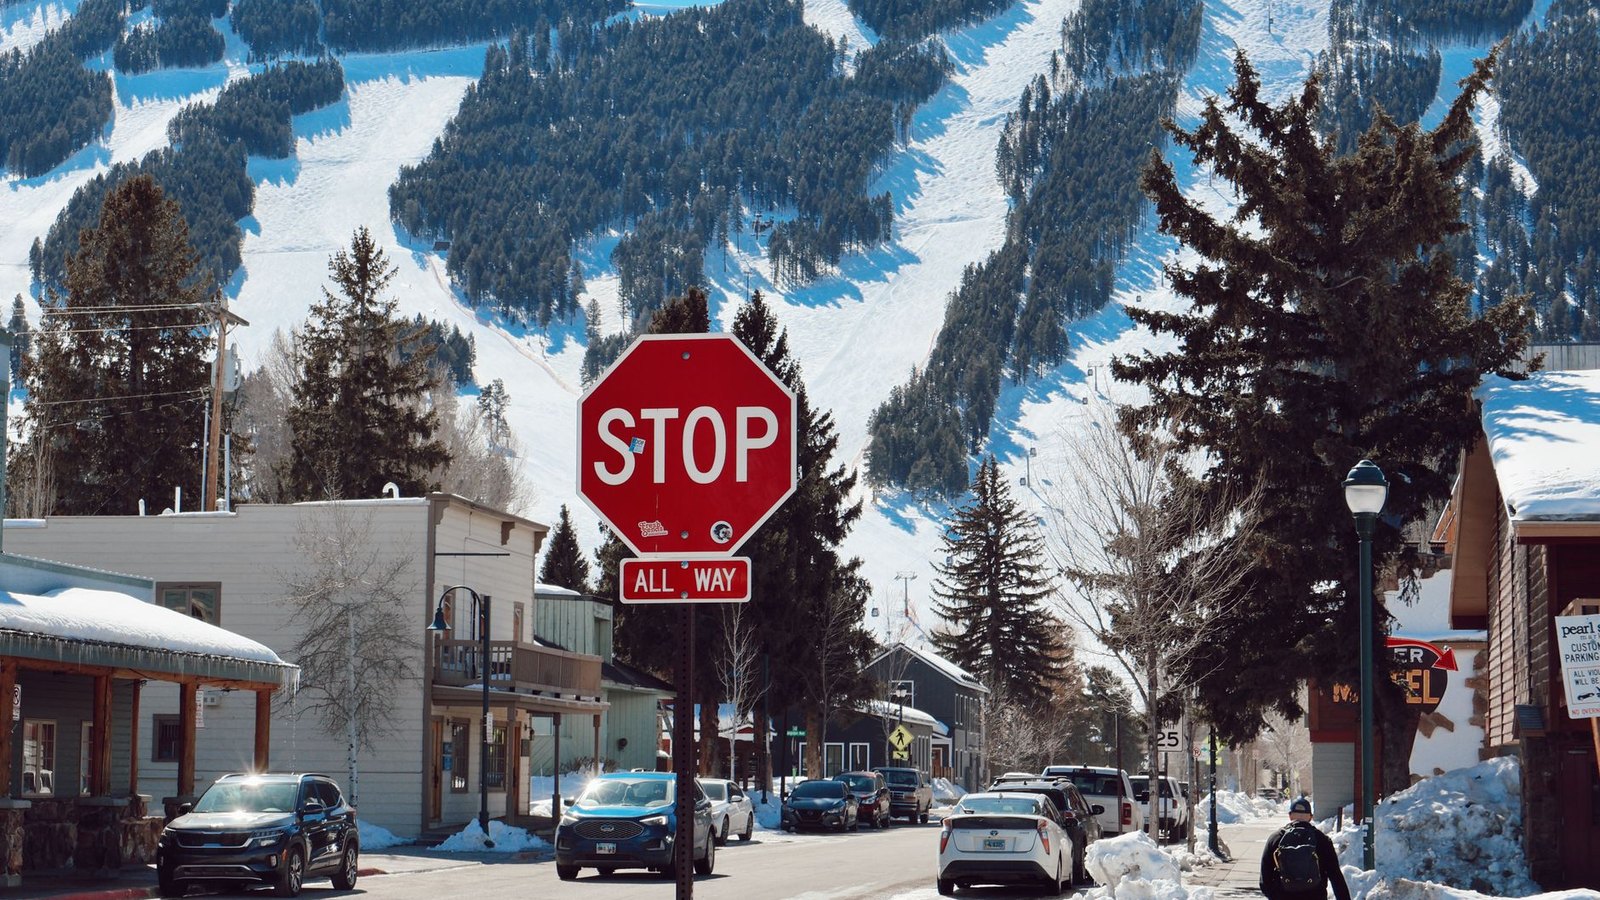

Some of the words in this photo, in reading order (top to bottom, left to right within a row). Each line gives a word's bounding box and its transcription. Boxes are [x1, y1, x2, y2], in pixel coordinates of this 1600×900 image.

[593, 406, 779, 486] STOP
[634, 568, 674, 593] ALL
[694, 567, 737, 592] WAY
[1561, 622, 1595, 638] pearl
[1565, 651, 1600, 663] PARKING
[1157, 732, 1179, 747] 25
